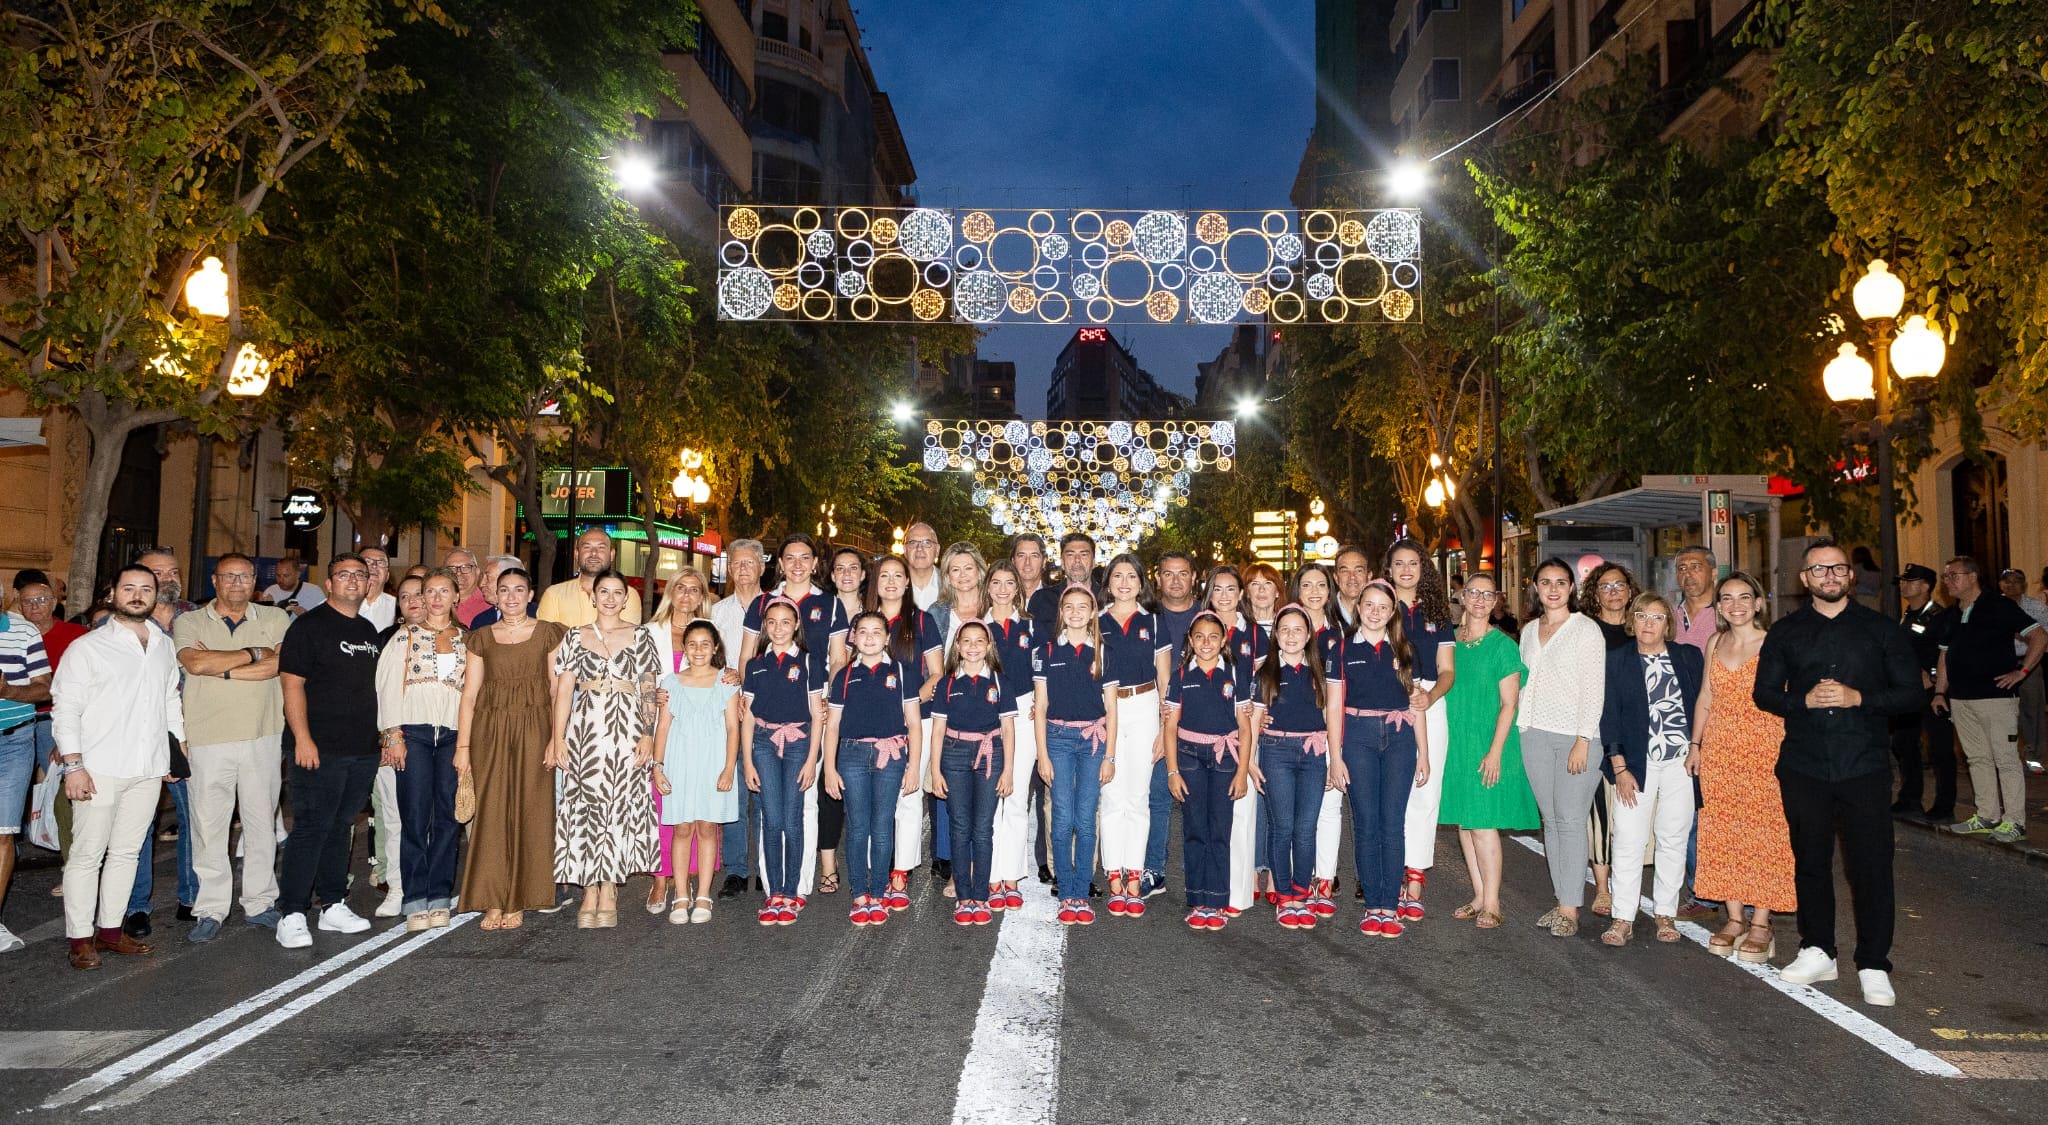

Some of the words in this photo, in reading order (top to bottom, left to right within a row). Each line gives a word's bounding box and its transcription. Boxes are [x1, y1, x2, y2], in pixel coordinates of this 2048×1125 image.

[551, 486, 595, 498] JOER
[1716, 493, 1724, 508] 8
[1712, 508, 1727, 523] 13
